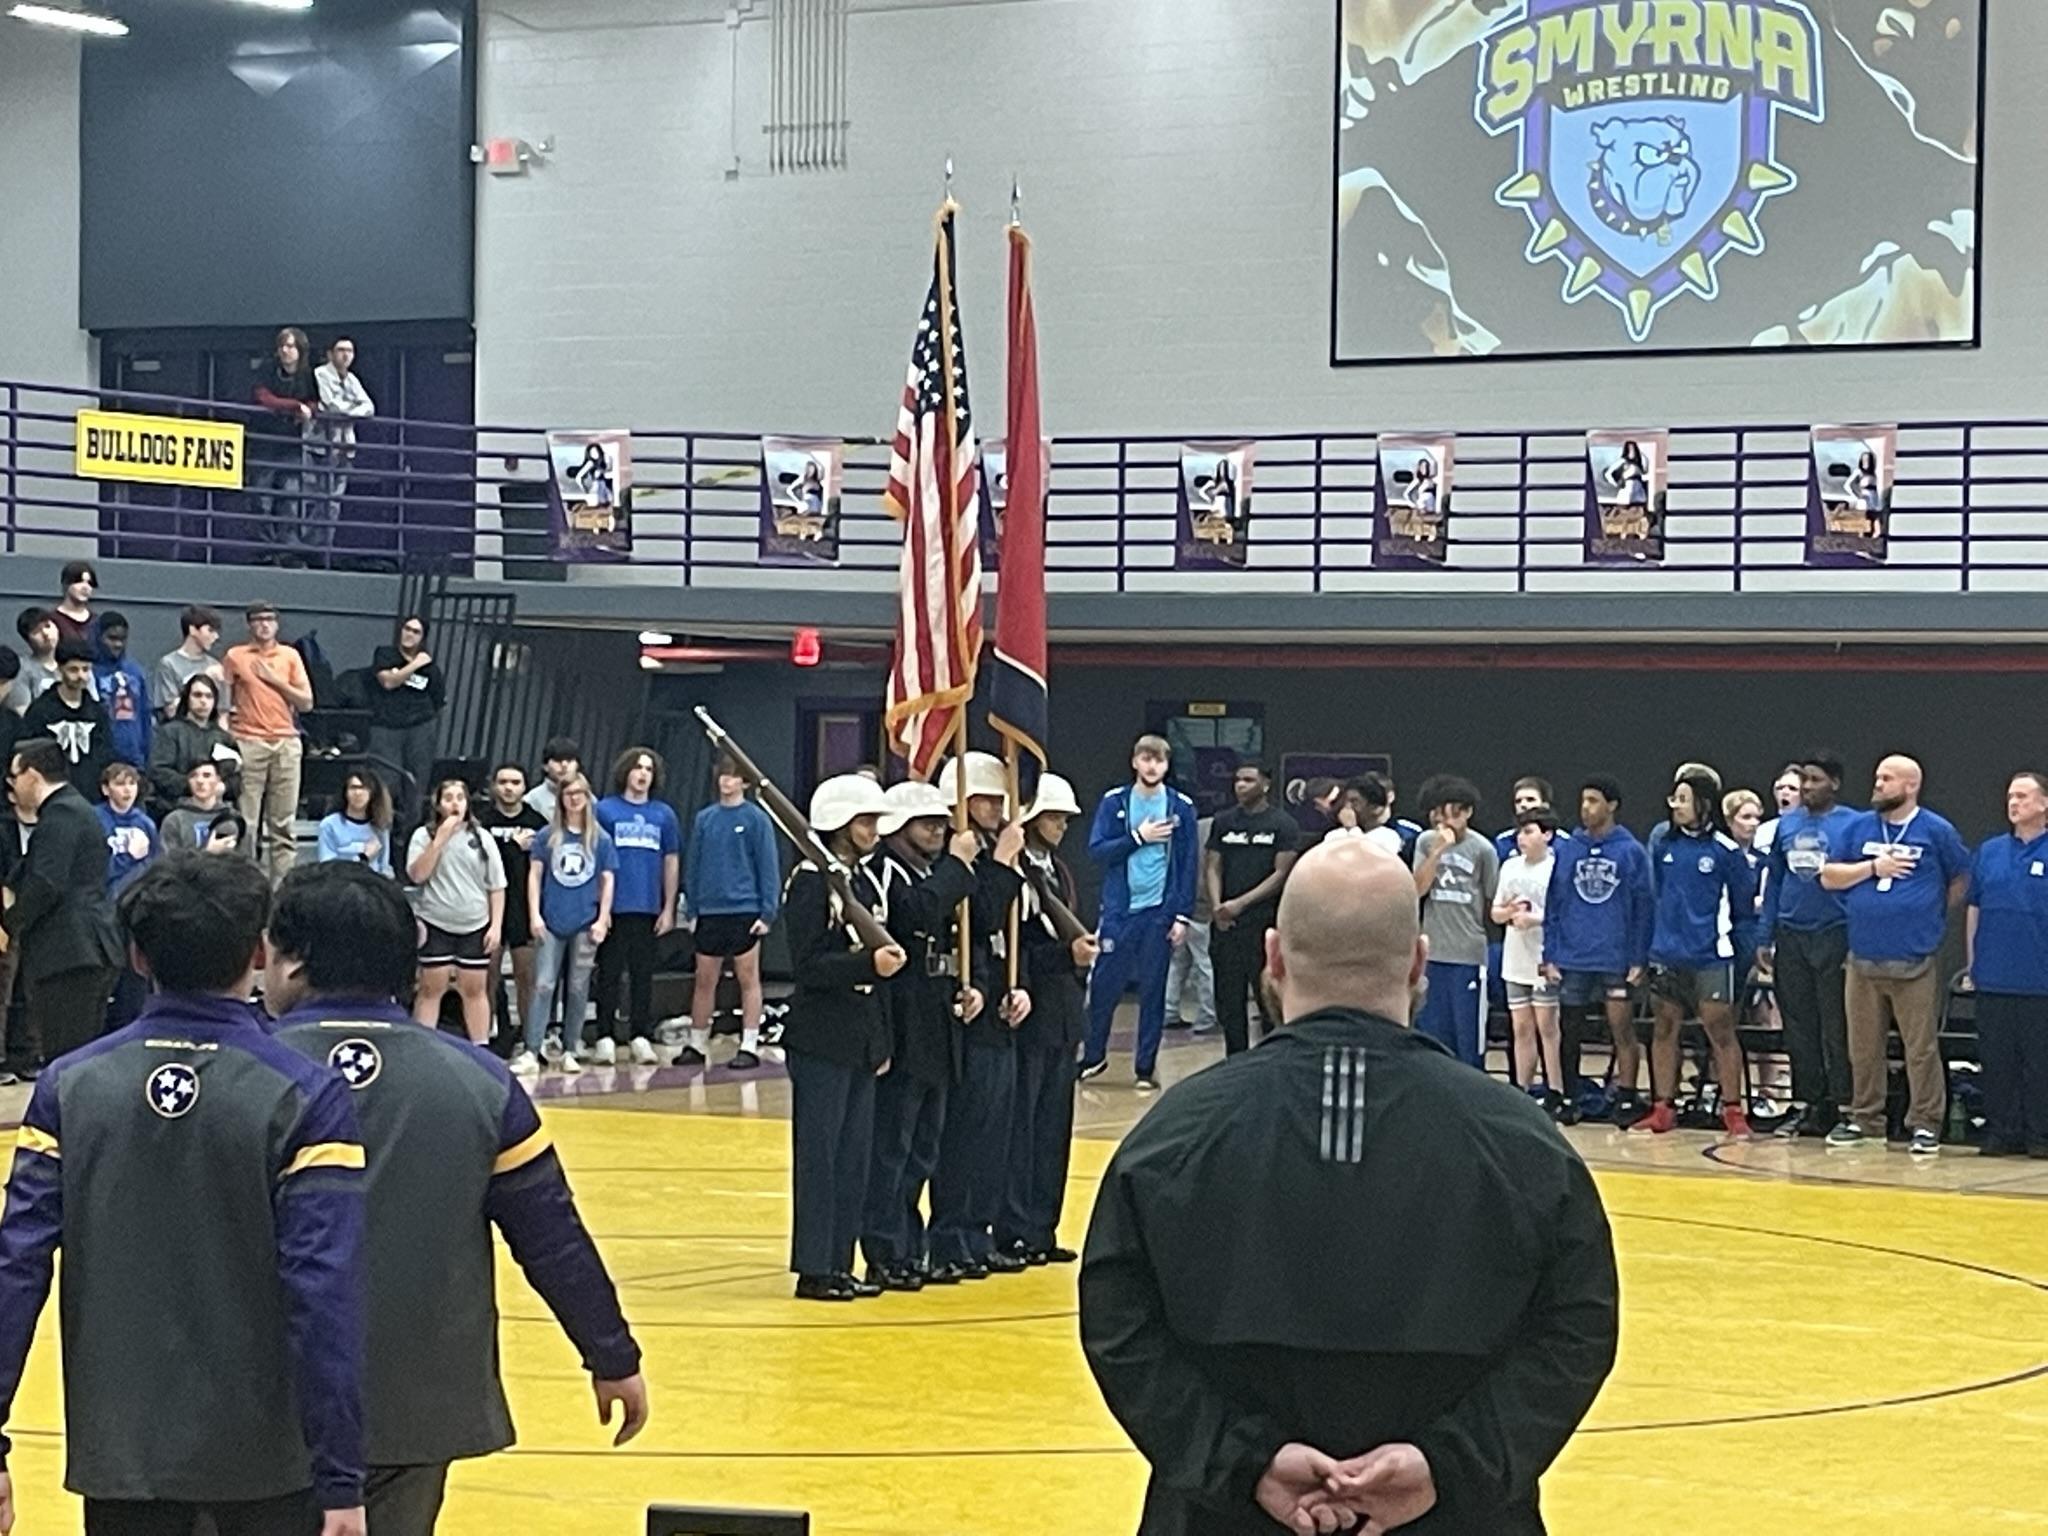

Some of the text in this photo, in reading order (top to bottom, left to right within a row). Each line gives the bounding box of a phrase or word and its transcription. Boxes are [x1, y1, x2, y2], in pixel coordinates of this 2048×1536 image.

[1487, 0, 1810, 119] SMYRNA
[1563, 73, 1731, 107] WRESTLING
[86, 427, 234, 471] BULLDOG FANS
